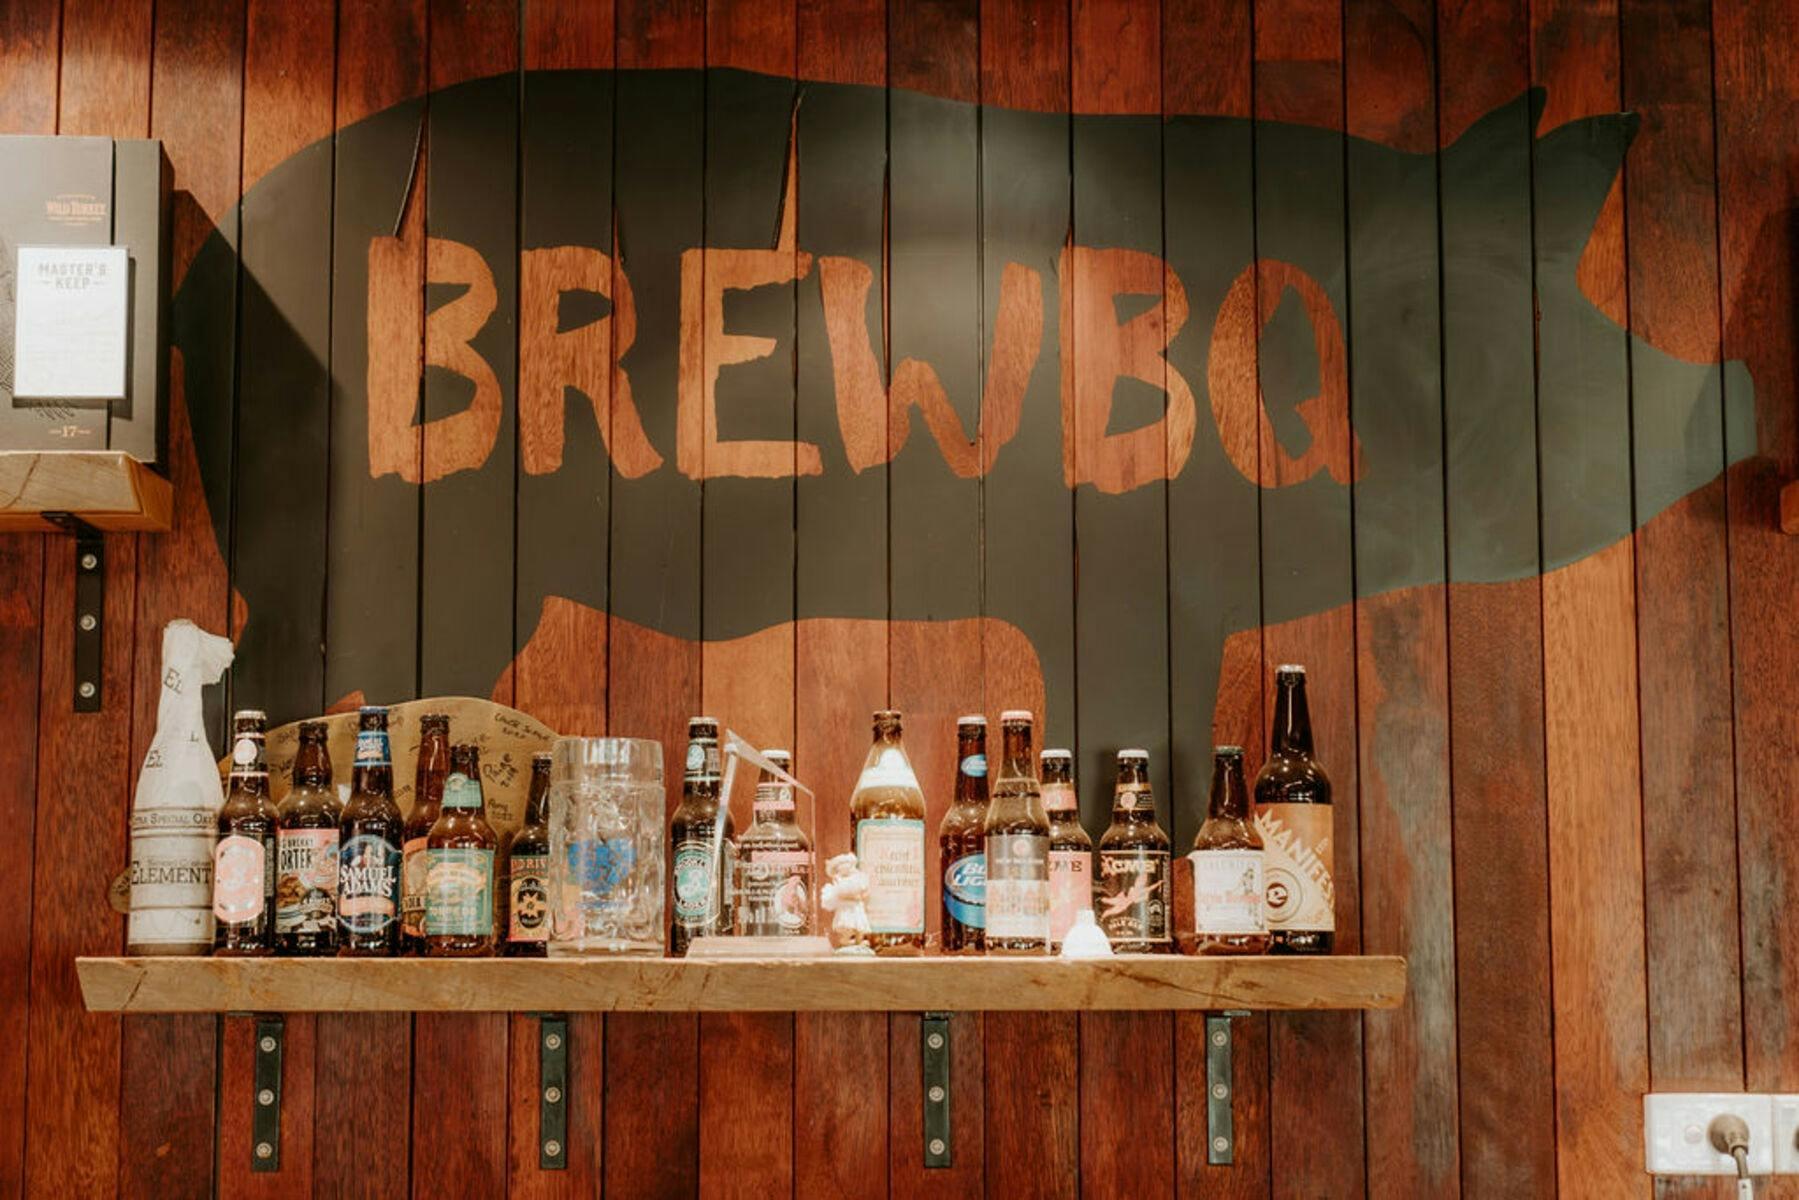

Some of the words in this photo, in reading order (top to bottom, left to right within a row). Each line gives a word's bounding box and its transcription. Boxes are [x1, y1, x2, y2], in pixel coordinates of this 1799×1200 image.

[38, 260, 107, 277] MASTER'S
[55, 276, 91, 290] KEEP
[367, 236, 1366, 496] BREWBQ
[341, 864, 397, 884] SAMUEL
[343, 881, 393, 899] ADAMS
